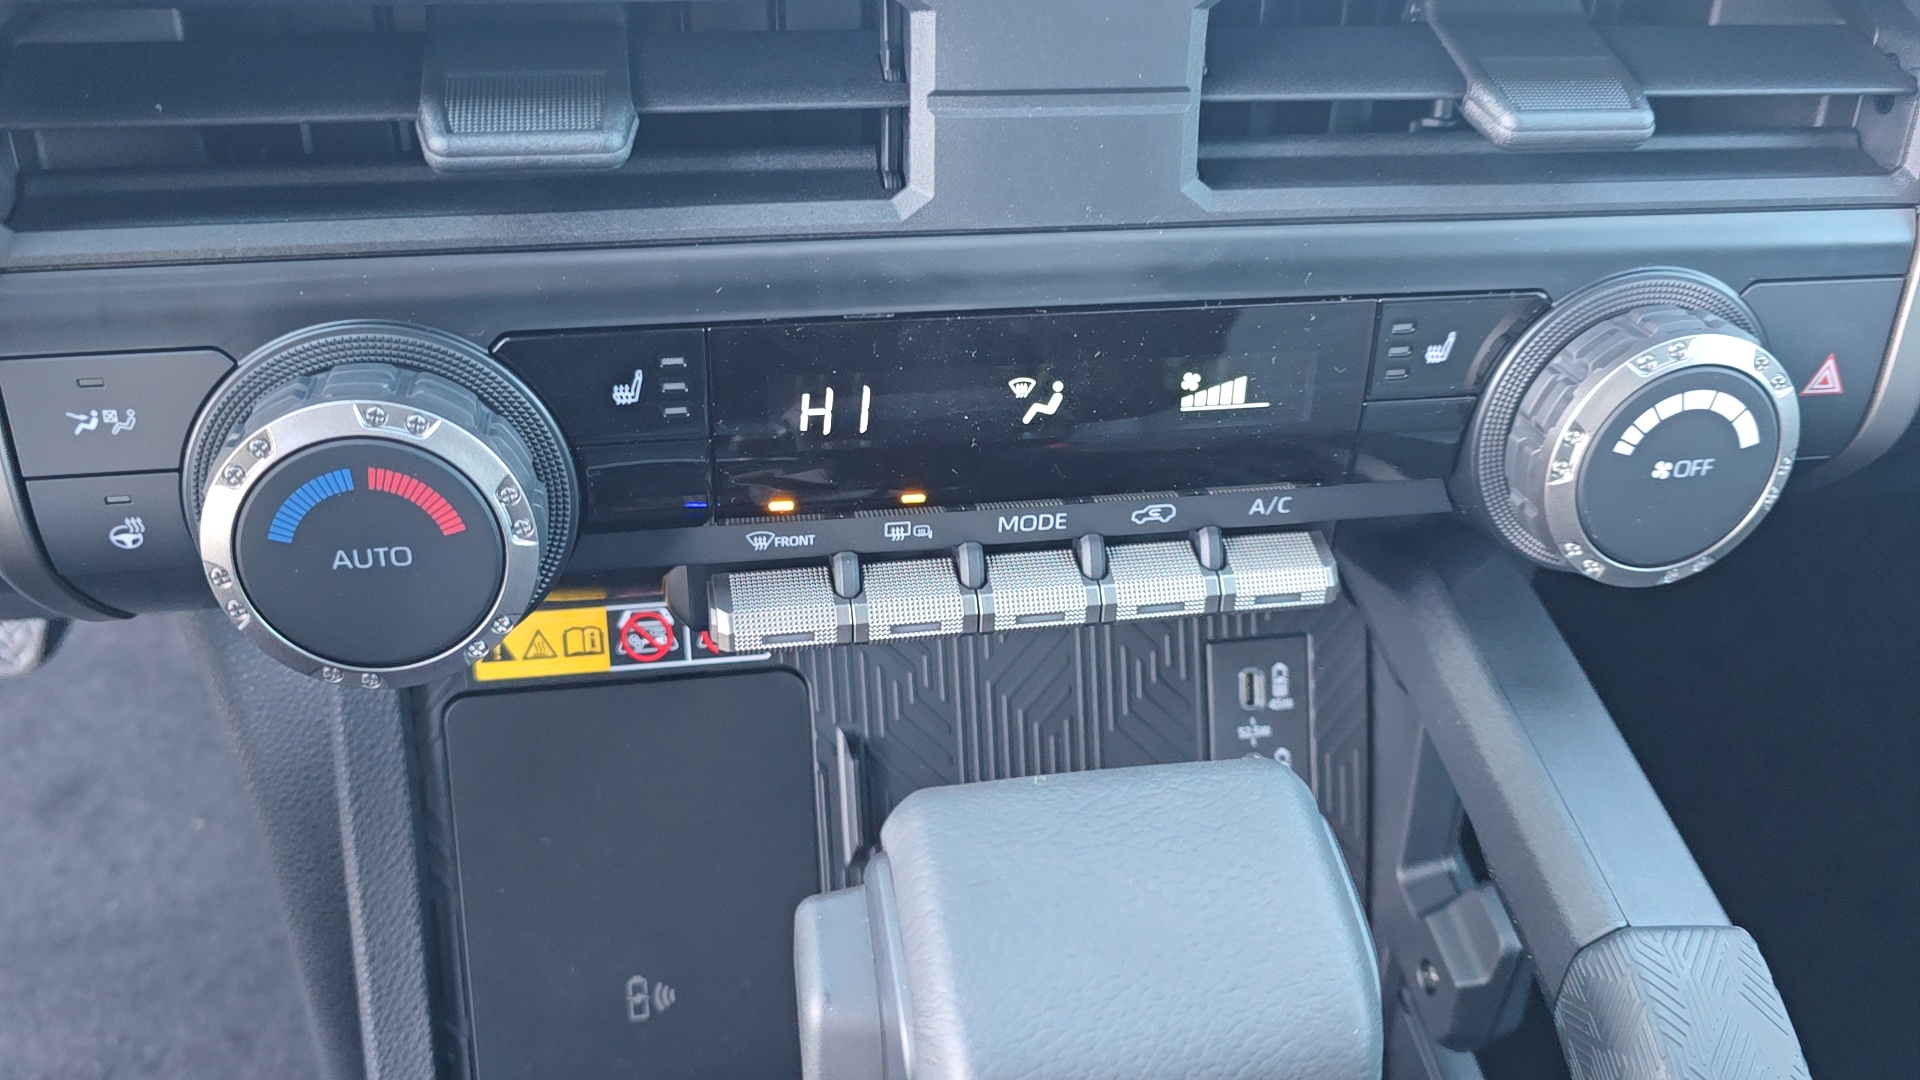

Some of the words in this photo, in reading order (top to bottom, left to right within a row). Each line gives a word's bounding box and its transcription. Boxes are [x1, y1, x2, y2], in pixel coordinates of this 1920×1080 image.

[799, 385, 871, 436] HI
[1673, 458, 1716, 478] OFF
[1248, 495, 1293, 516] A/C
[997, 512, 1068, 534] MODE
[774, 534, 816, 548] FRONT
[332, 546, 413, 570] AUTO
